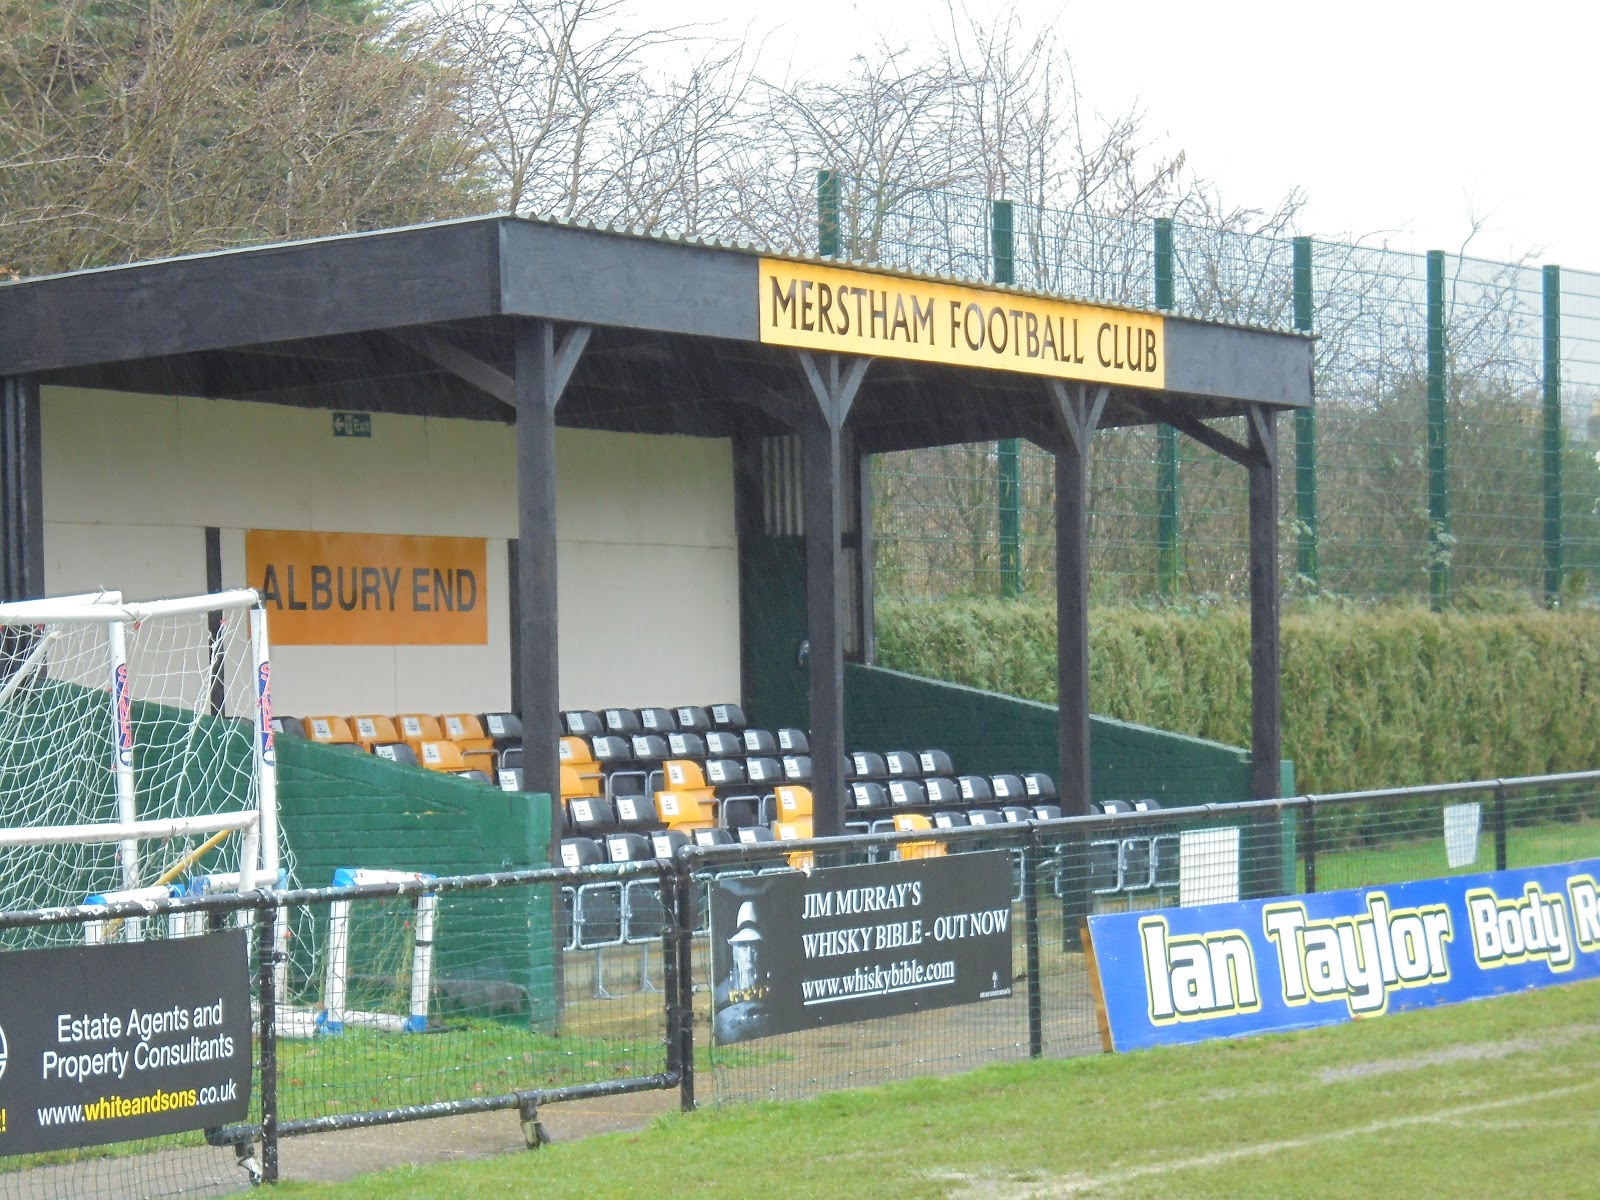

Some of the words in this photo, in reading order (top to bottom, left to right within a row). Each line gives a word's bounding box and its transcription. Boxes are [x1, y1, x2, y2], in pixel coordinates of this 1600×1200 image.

[769, 275, 936, 346] MERSTHAM
[949, 300, 1085, 365] FOOTBALL
[1096, 322, 1158, 374] CLUB
[258, 563, 402, 612] ALBURY
[412, 567, 477, 612] END
[802, 891, 832, 920] JIM
[836, 881, 922, 915] MURRAY'S
[802, 925, 872, 959] WHISKY
[874, 920, 922, 951] BIBLE
[933, 913, 968, 942] OUT
[970, 909, 1009, 937] NOW
[1140, 917, 1260, 1024] Ian
[1264, 892, 1452, 1016] Taylor
[1466, 883, 1574, 972] Body
[802, 959, 955, 1000] www.whiskybible.com
[57, 1012, 122, 1043] Estate
[126, 1005, 189, 1041] Agents
[193, 998, 223, 1027] and
[43, 1047, 129, 1082] Property
[134, 1032, 234, 1070] Consultants
[37, 1078, 237, 1126] www.whiteandsons.co.uk
